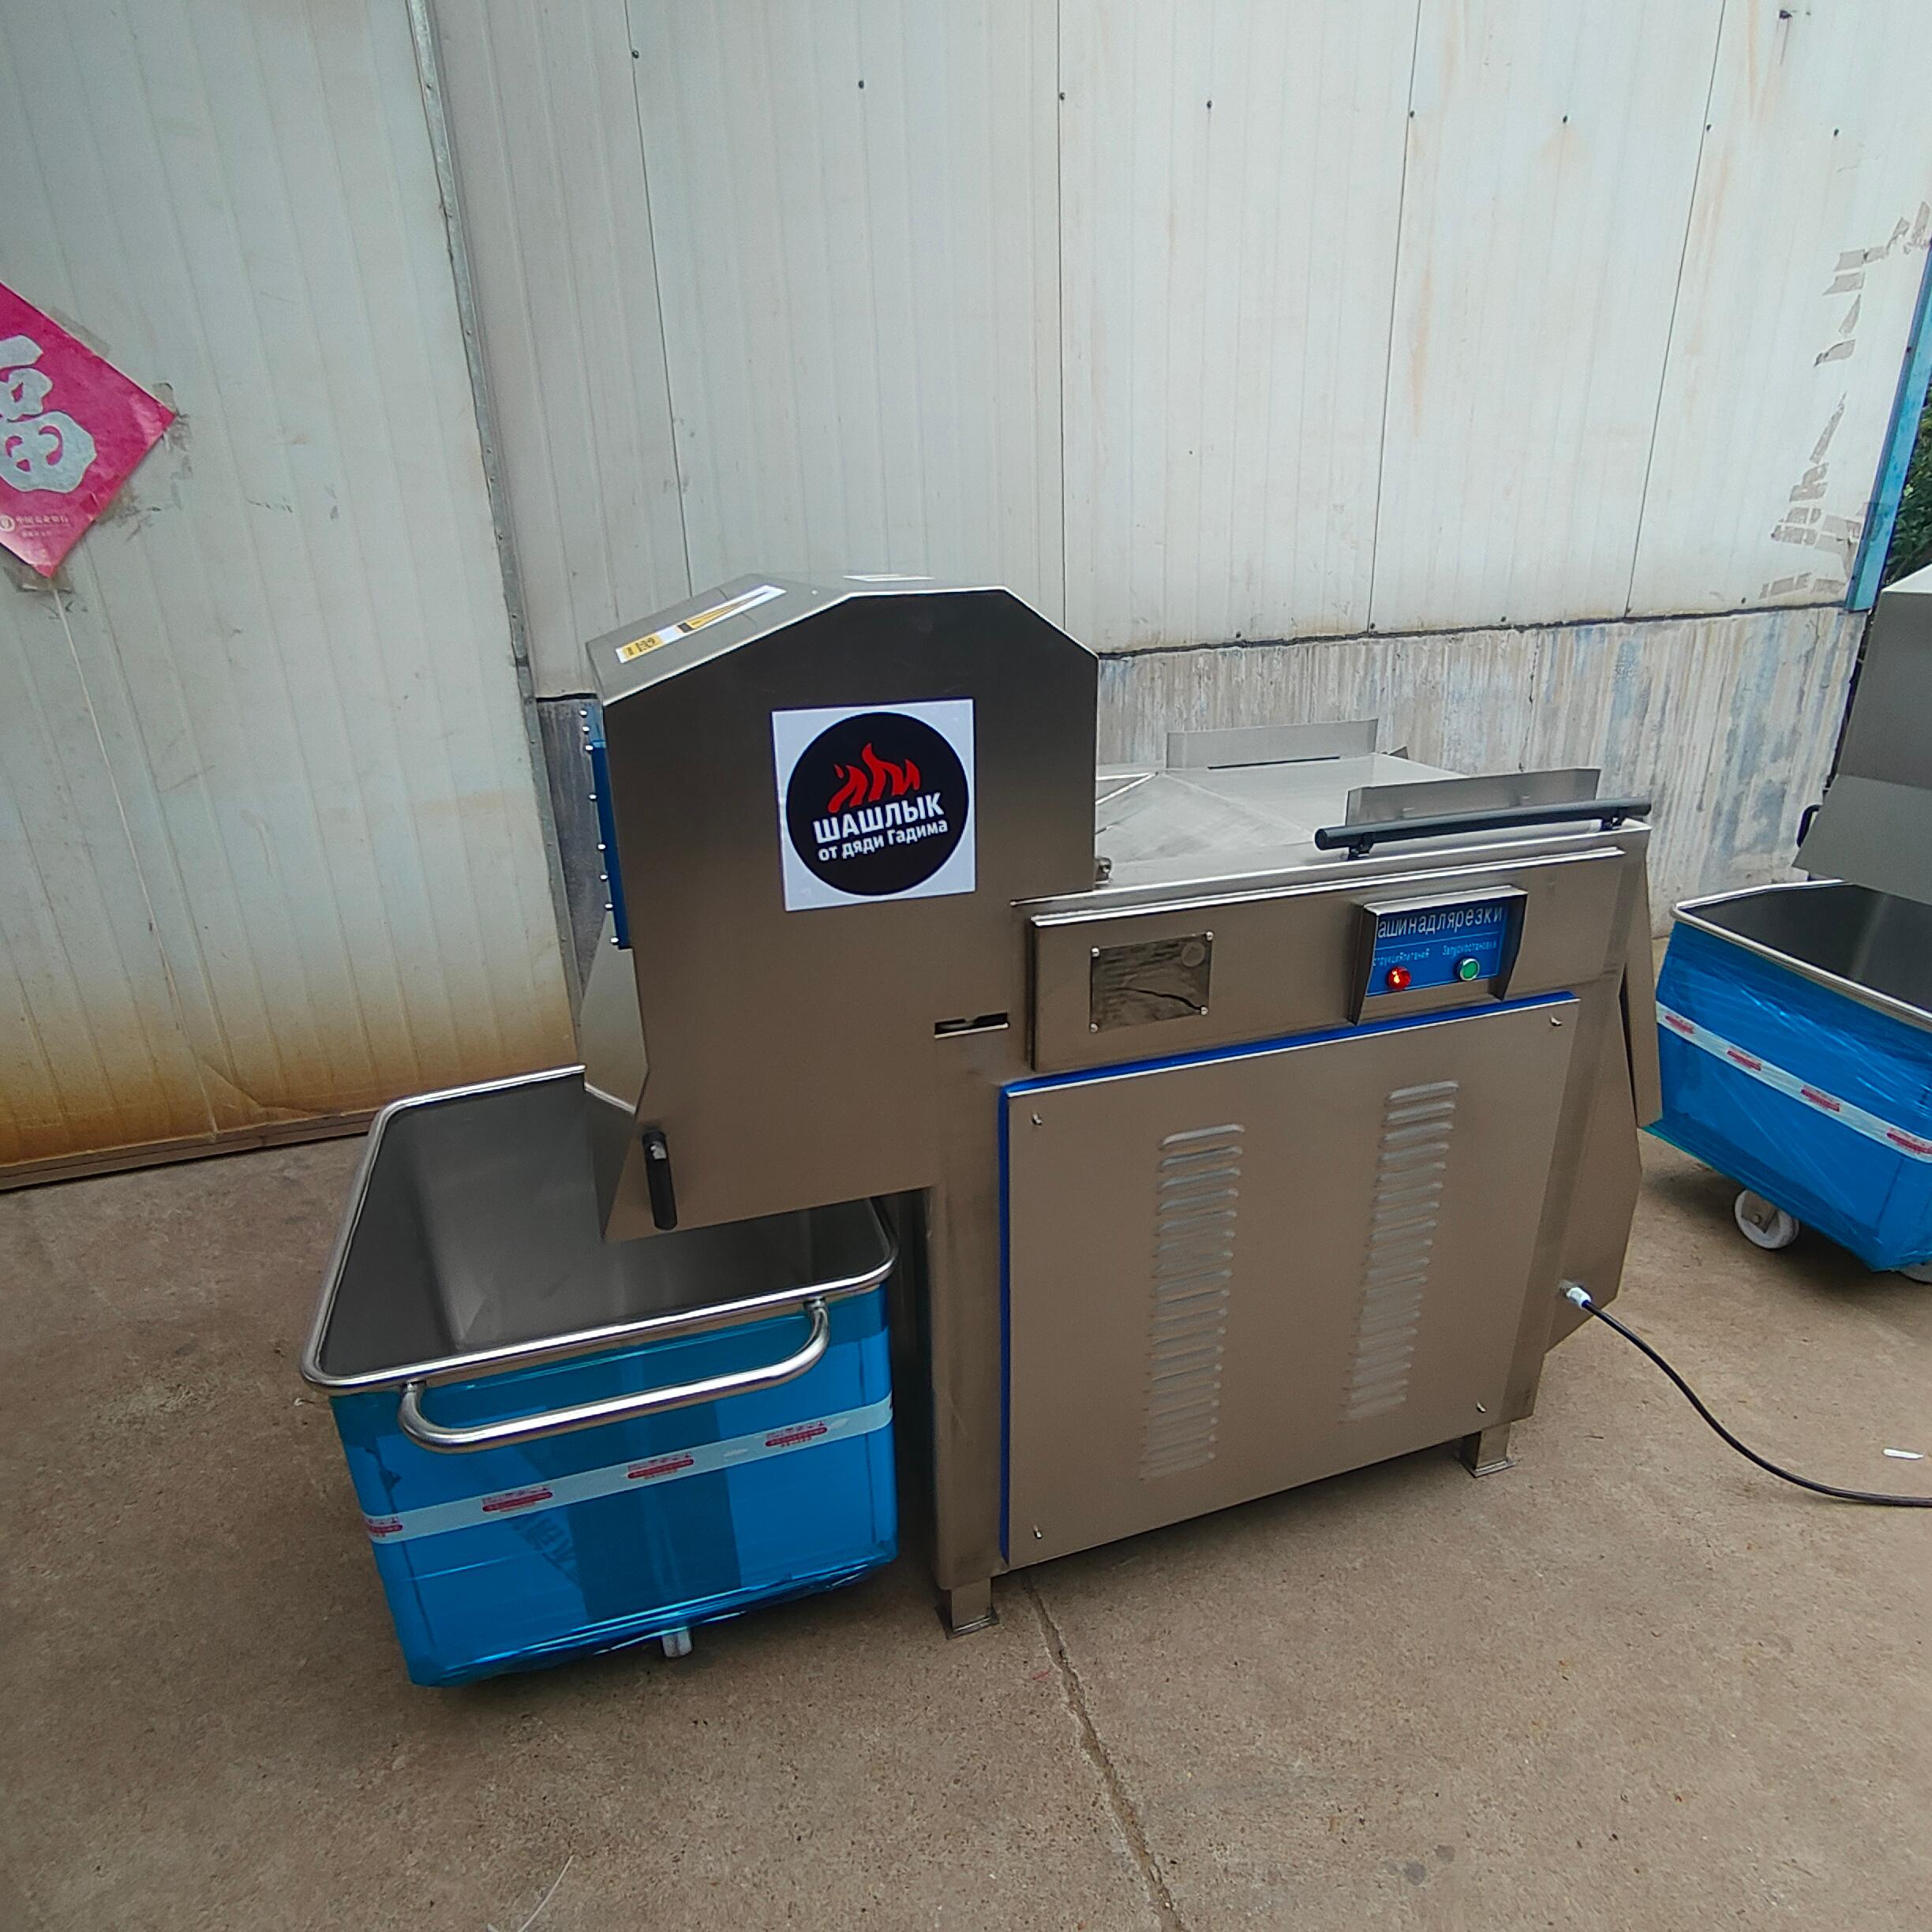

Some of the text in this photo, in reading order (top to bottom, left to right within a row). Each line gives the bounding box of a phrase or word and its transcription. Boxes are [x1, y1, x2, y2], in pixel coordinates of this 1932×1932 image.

[813, 792, 945, 844] ШАШЛЫК
[818, 819, 948, 861] от дяди Гадима
[1378, 908, 1502, 938] ашинадлярезки
